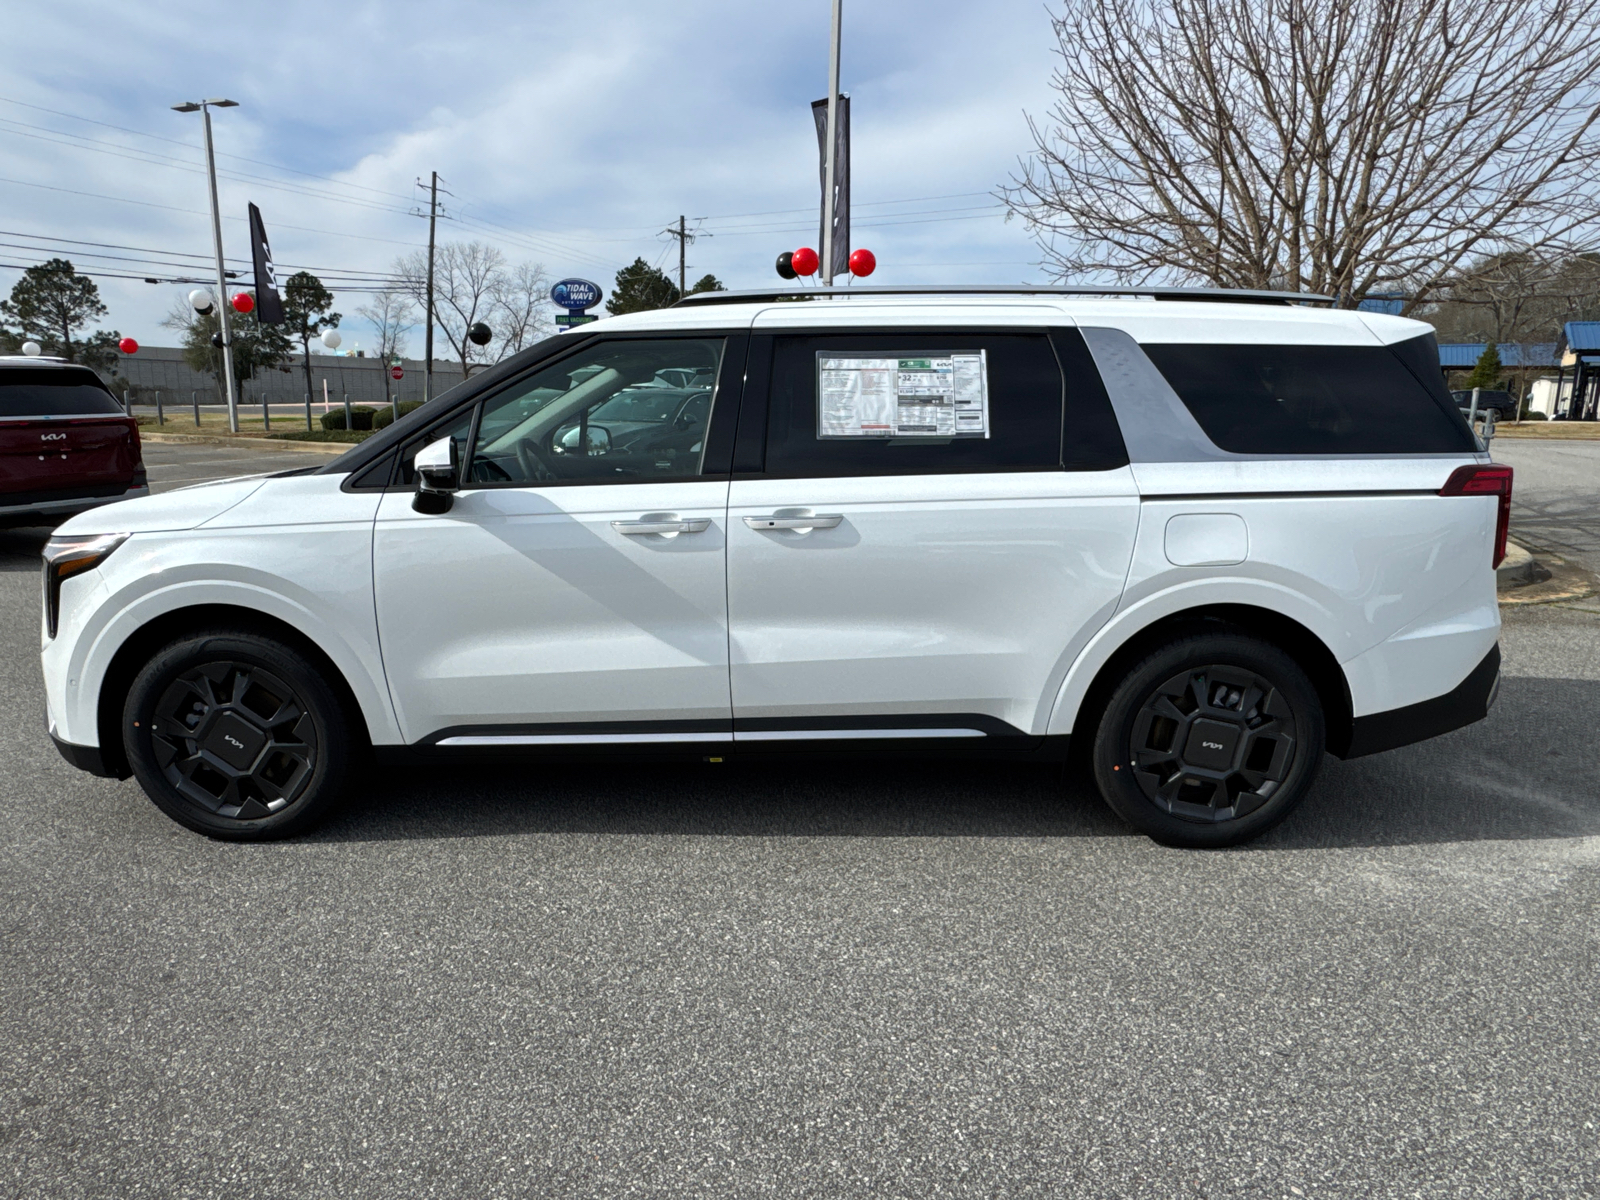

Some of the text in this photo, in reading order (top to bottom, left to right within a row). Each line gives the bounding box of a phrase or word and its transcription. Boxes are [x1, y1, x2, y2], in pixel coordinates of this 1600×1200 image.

[570, 292, 593, 300] WAVE
[391, 369, 404, 377] STOP
[902, 374, 912, 382] 32
